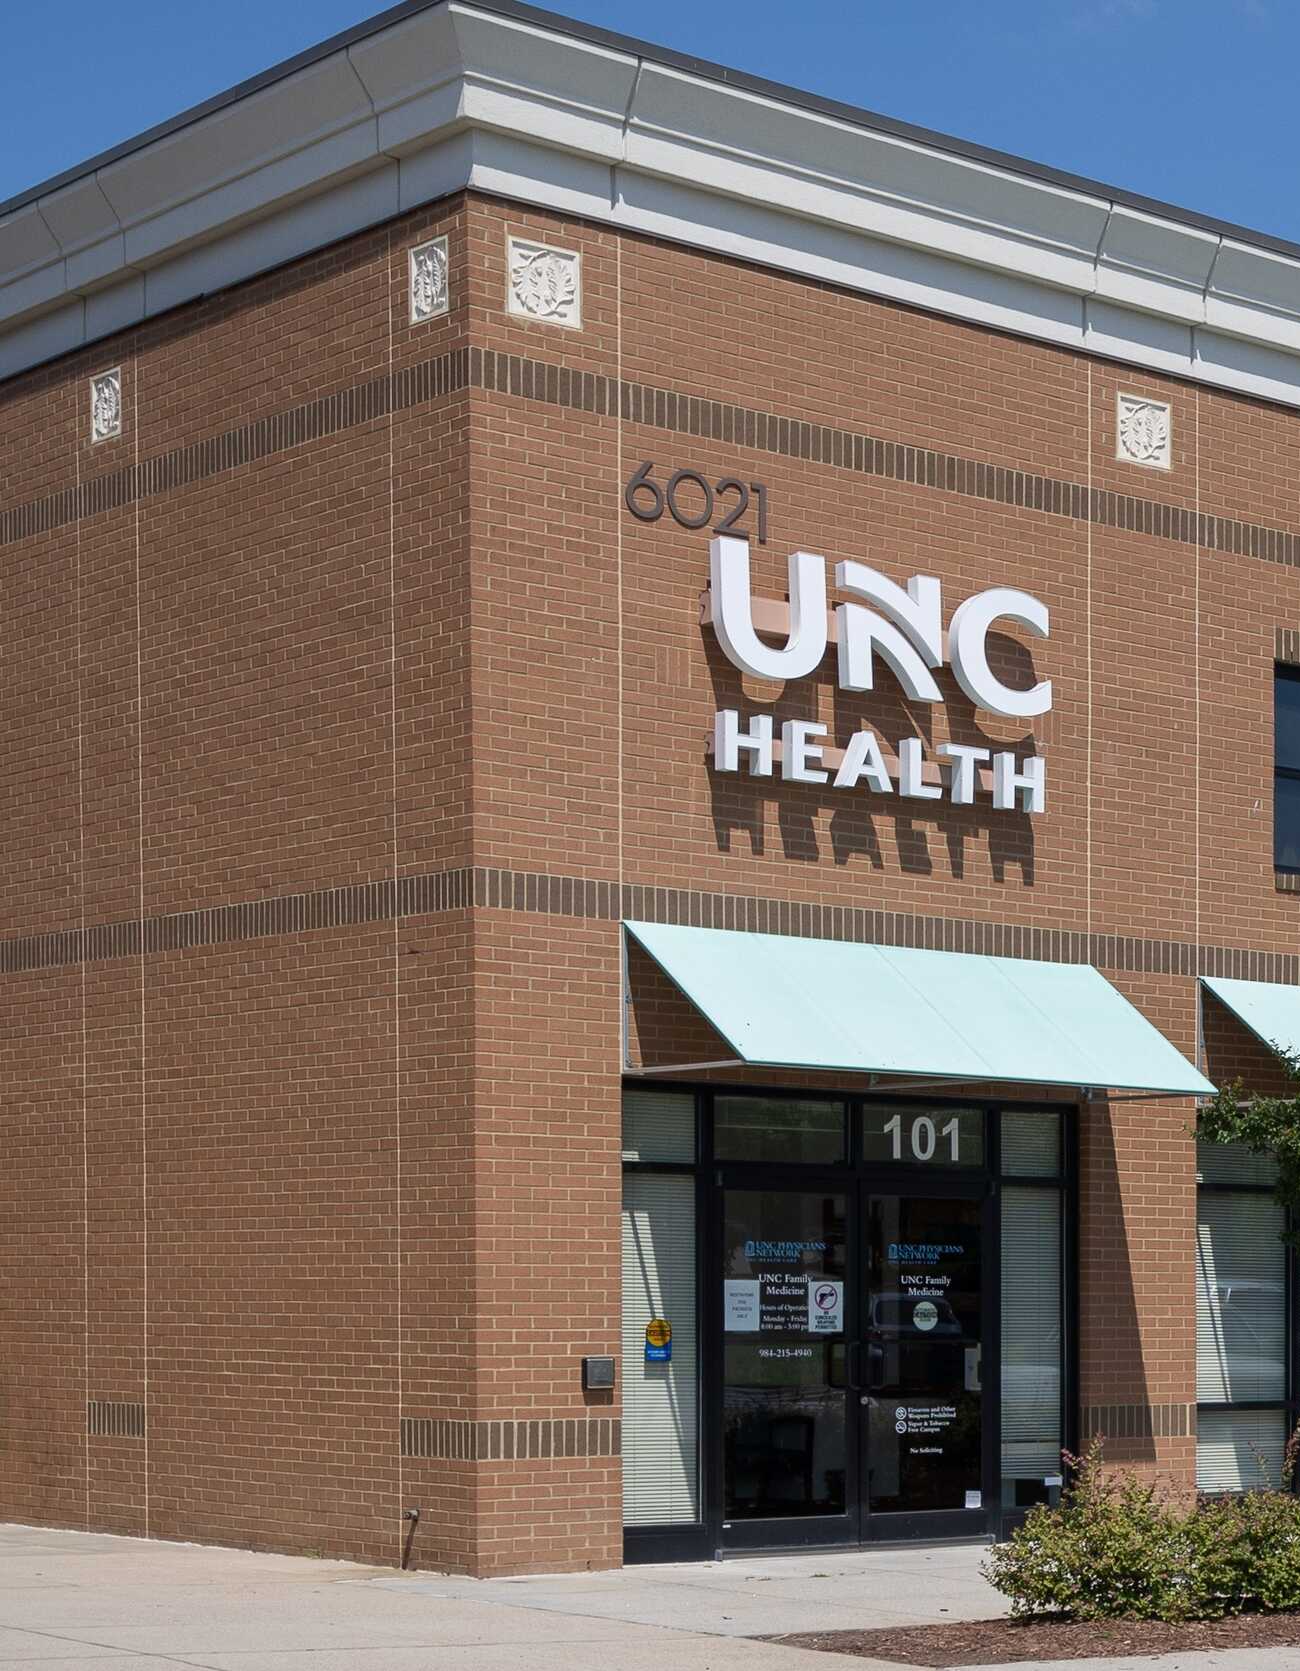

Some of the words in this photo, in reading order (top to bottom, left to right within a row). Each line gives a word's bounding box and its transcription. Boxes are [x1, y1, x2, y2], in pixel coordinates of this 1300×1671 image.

[625, 461, 767, 543] 6021
[709, 536, 1052, 717] UNC
[715, 709, 1046, 813] HEALTH
[883, 1114, 959, 1161] 101
[759, 1273, 782, 1283] UNC
[785, 1273, 813, 1283] Family
[766, 1286, 805, 1295] Medicine
[901, 1275, 923, 1285] UNC
[925, 1275, 951, 1287] Family
[908, 1287, 944, 1296] Medicine
